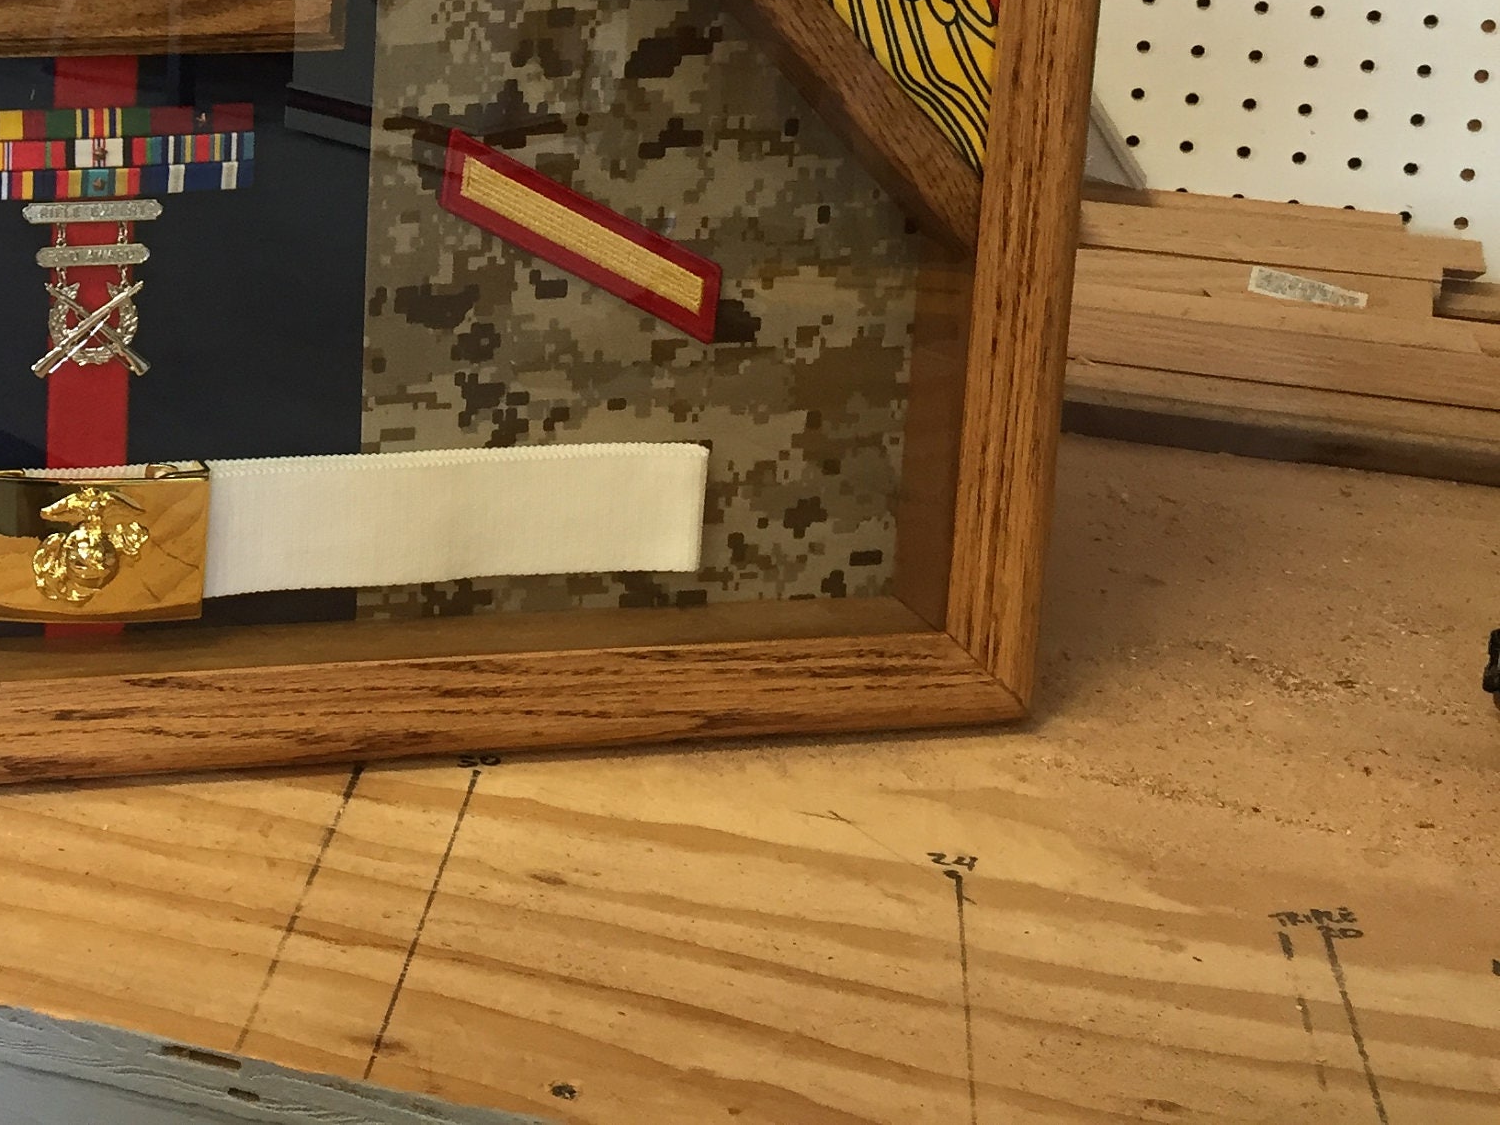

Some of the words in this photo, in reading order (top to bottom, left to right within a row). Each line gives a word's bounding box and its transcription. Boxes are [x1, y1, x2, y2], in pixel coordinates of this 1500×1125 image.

[40, 203, 81, 218] RIFLE
[926, 852, 978, 872] 24
[1267, 906, 1357, 927] TRIPLE
